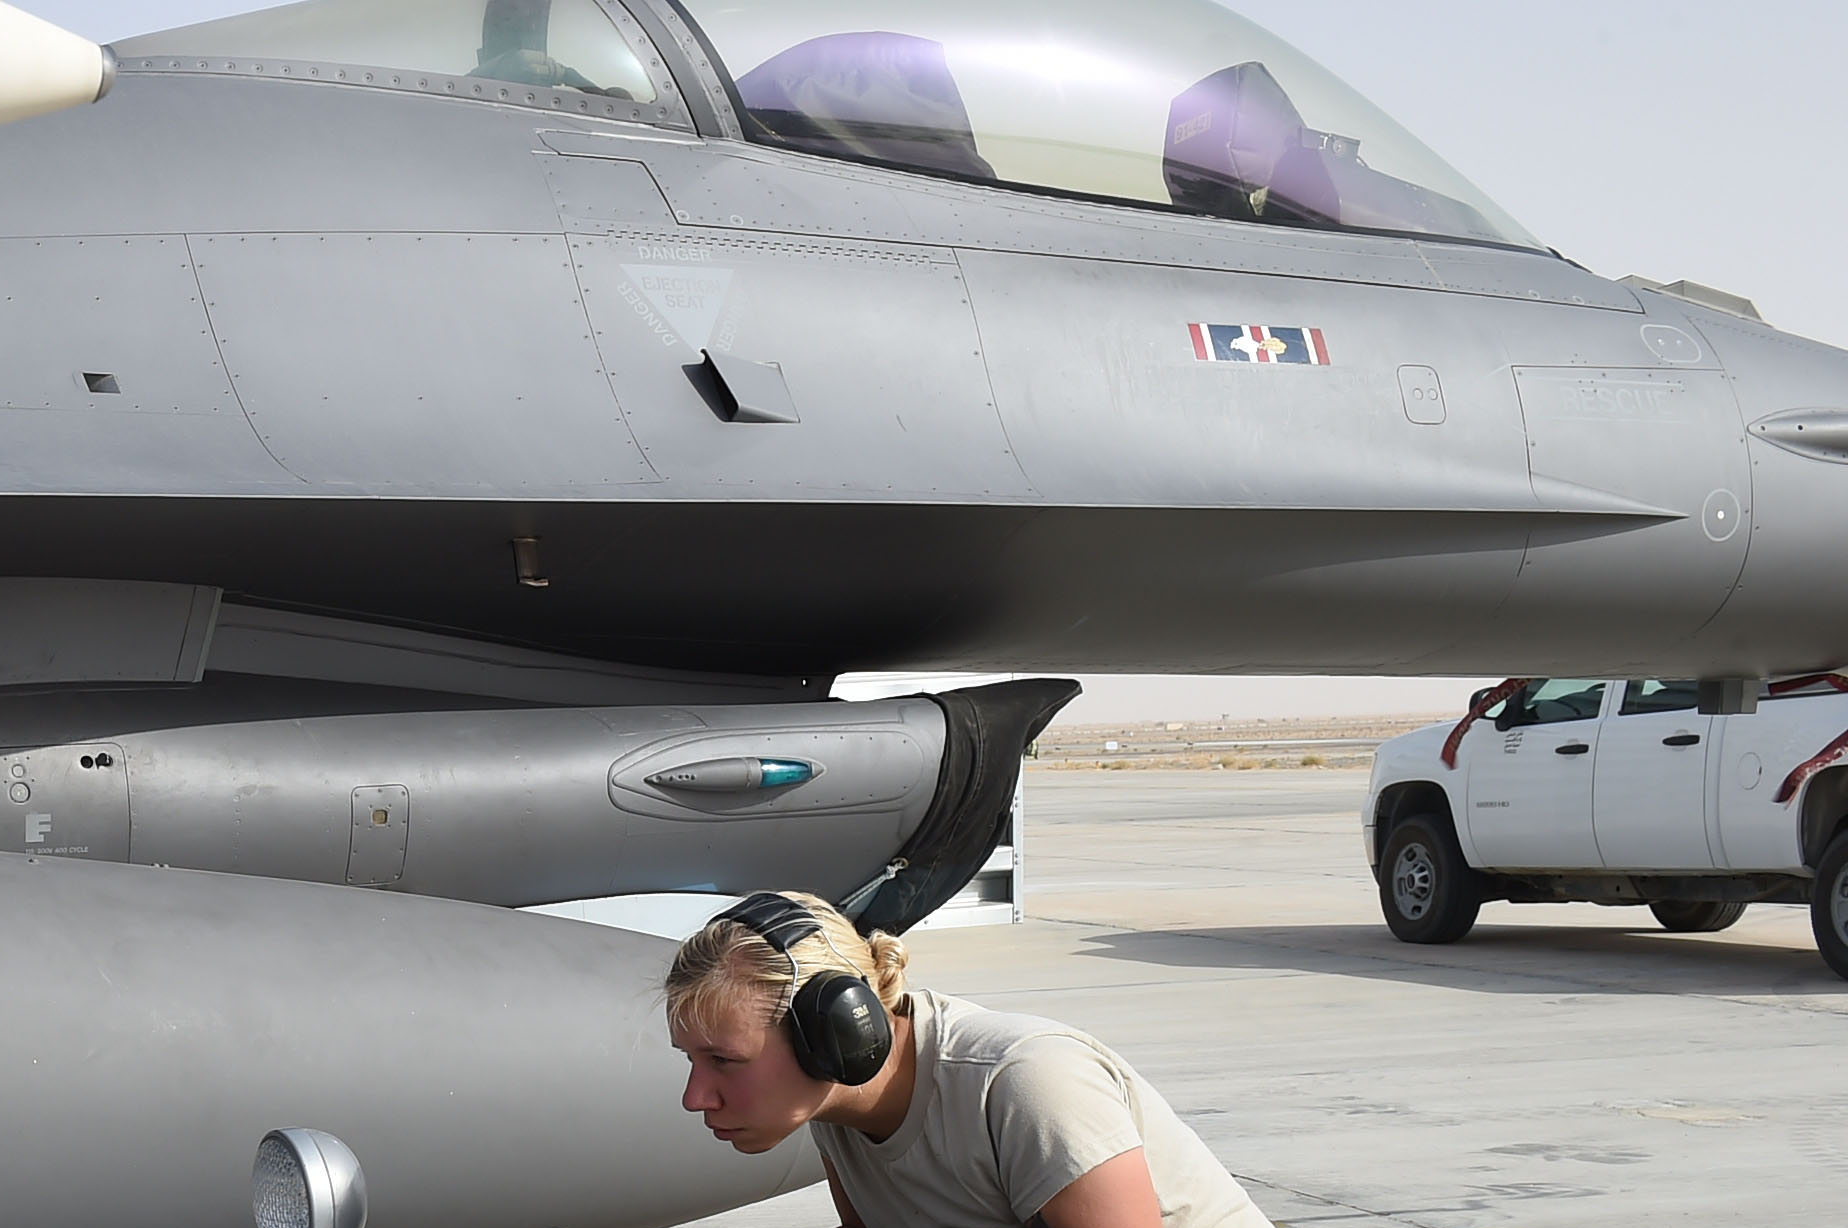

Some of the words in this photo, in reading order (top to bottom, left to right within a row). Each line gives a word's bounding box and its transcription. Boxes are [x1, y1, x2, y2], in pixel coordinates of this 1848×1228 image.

[638, 245, 712, 263] DANGER
[641, 276, 721, 294] EJECTION
[664, 295, 705, 310] SEAT
[616, 280, 678, 348] DANGER
[1558, 385, 1673, 416] RESCUE
[852, 1004, 870, 1019] 3M
